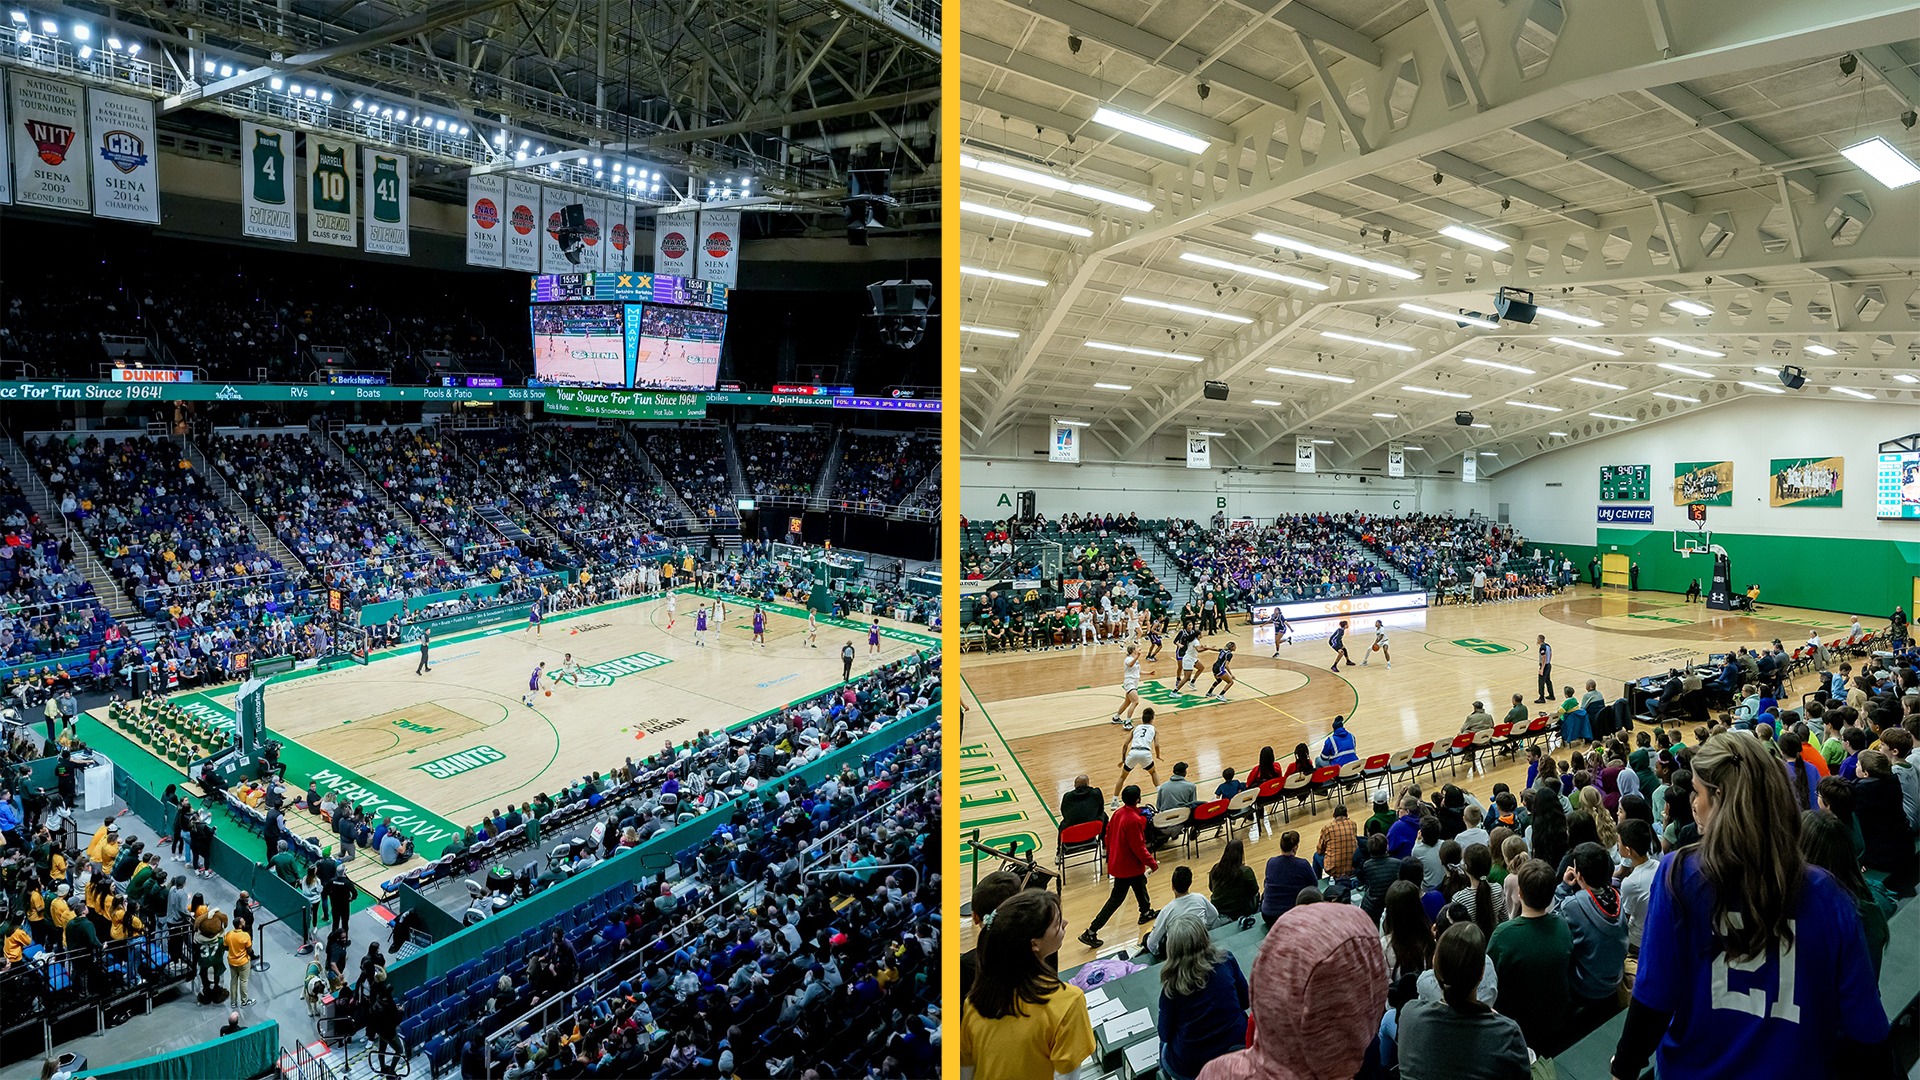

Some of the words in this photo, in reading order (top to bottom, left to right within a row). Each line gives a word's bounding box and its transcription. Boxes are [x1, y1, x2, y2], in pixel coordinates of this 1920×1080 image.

[26, 80, 69, 95] NATIONAL
[19, 89, 76, 107] INVITATIONAL
[20, 100, 77, 117] TOURNAMENT
[105, 102, 138, 113] COLLEGE
[99, 108, 145, 123] BASKETBALL
[96, 116, 149, 131] INVITATIONAL
[34, 124, 70, 146] NIT
[108, 134, 140, 156] CBI
[320, 154, 342, 168] HARRELL
[262, 156, 276, 181] 4
[34, 170, 71, 182] SIENA
[477, 176, 495, 186] NCAA
[42, 182, 66, 193] 2003
[106, 178, 145, 192] SIENA
[320, 171, 344, 200] 10
[377, 178, 396, 202] 41
[514, 184, 532, 194] NCAA
[23, 192, 54, 202] SECOND
[58, 196, 84, 206] ROUND
[113, 190, 140, 202] 2014
[550, 192, 567, 201] NCAA
[105, 201, 149, 212] CHAMPIONS
[478, 206, 494, 215] NAC
[250, 206, 291, 228] SIENA
[472, 214, 500, 223] CHAMPIONS
[512, 211, 533, 222] MAAC
[316, 213, 349, 232] SIENA
[510, 220, 535, 229] CHAMPIONS
[248, 226, 267, 234] CLASS
[268, 228, 277, 236] OF
[313, 230, 330, 239] CLASS
[340, 234, 352, 242] 1952
[370, 226, 405, 244] SIENA
[474, 232, 497, 242] SIENA
[512, 238, 533, 247] SIENA
[368, 242, 383, 250] CLASS
[479, 241, 493, 249] 1989
[515, 246, 529, 254] 1999
[563, 275, 579, 283] 15:04
[688, 280, 702, 289] 15:04
[551, 288, 559, 296] 10
[586, 287, 591, 295] 8
[674, 290, 683, 299] 10
[627, 308, 639, 349] MOHAWK
[587, 352, 618, 360] SIENA
[122, 370, 184, 382] DUNKIN'
[338, 376, 385, 385] BerkshireBank
[0, 387, 16, 398] ce
[20, 385, 49, 398] For
[52, 385, 81, 398] Fun
[85, 385, 122, 398] Since
[126, 385, 162, 399] 1964!
[290, 387, 308, 398] RVs
[357, 388, 380, 398] Boats
[424, 388, 444, 398] Pools
[445, 389, 452, 398] &
[454, 389, 473, 398] Patio
[508, 389, 522, 399] Skis
[523, 390, 530, 398] &
[557, 389, 575, 401] Your
[577, 390, 608, 403] Source
[610, 392, 630, 404] For
[633, 393, 652, 405] Fun
[655, 394, 676, 405] Since
[679, 394, 697, 405] 1964!
[770, 395, 832, 405] AlpinHaus.com
[601, 407, 635, 415] Snowboards
[1604, 472, 1612, 481] 34
[1637, 471, 1646, 480] 31
[997, 493, 1012, 507] A
[1217, 497, 1227, 508] B
[1393, 500, 1400, 510] C
[1616, 510, 1651, 518] CENTER
[1324, 602, 1370, 613] Seice
[822, 618, 858, 629] MVP
[875, 628, 936, 645] ARENA
[235, 660, 246, 668] 26
[595, 653, 669, 676] SIENA
[633, 718, 659, 730] MVP
[646, 717, 690, 735] ARENA
[1140, 728, 1147, 737] 3
[421, 745, 503, 778] SAINTS
[311, 769, 388, 806] ARENA
[391, 814, 451, 842] MVP
[200, 943, 218, 956] 37
[1712, 912, 1800, 1024] 21
